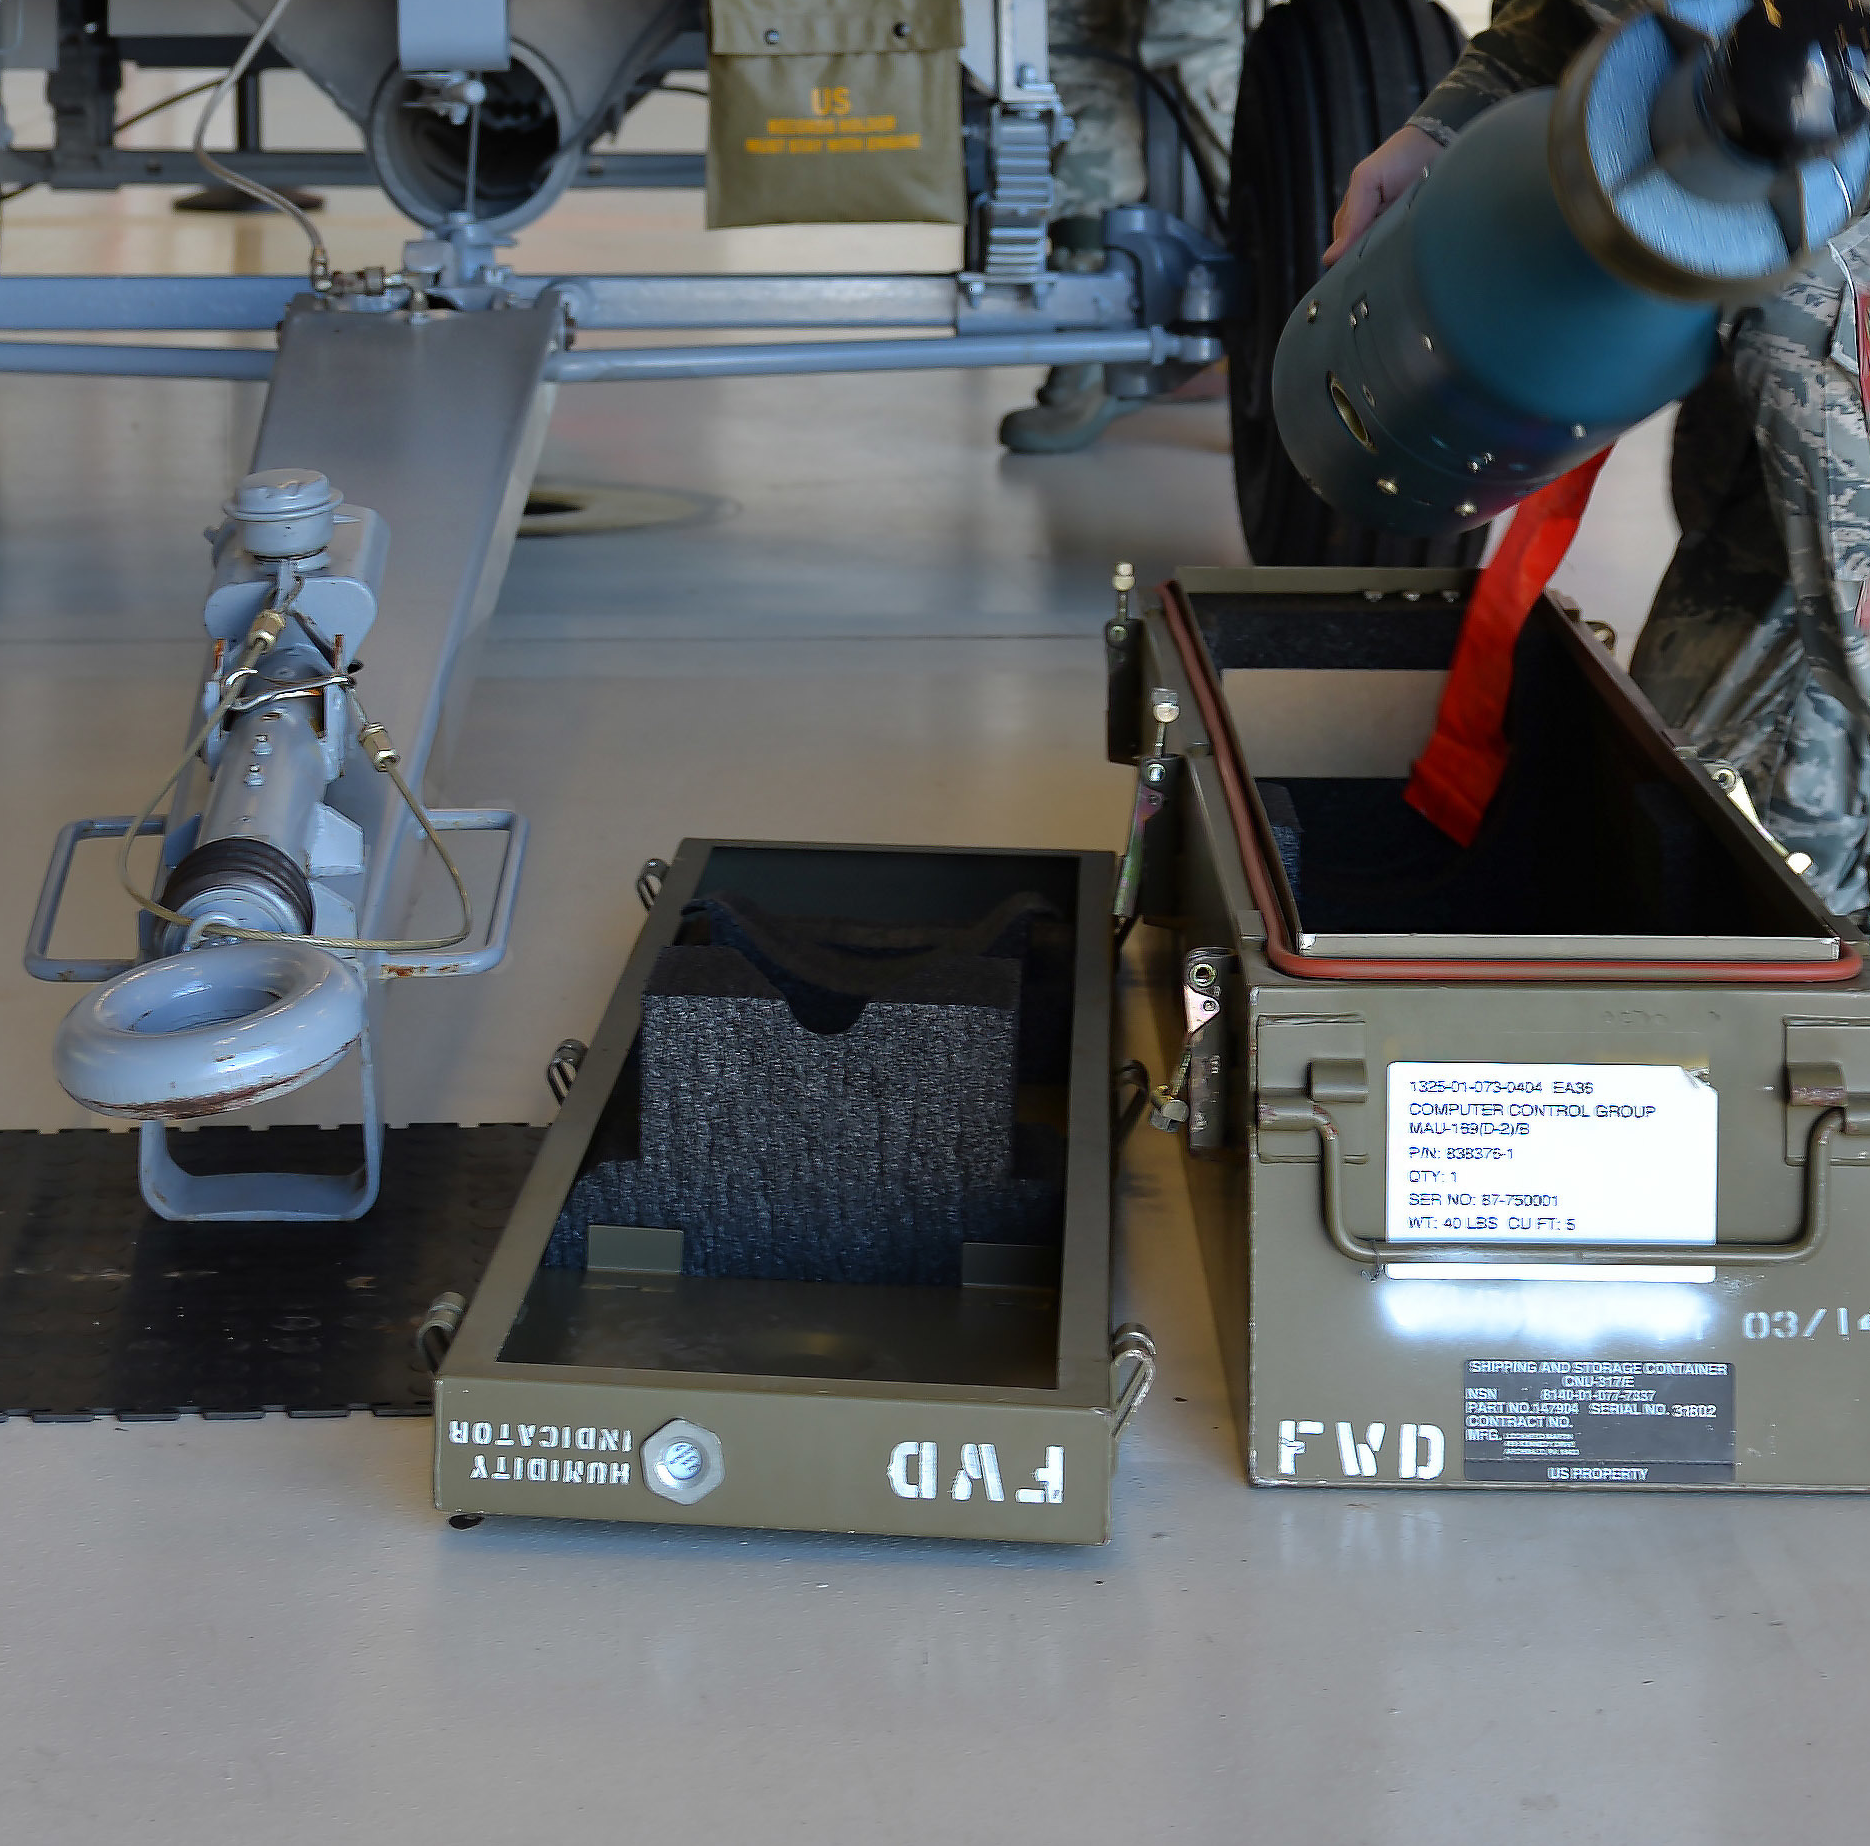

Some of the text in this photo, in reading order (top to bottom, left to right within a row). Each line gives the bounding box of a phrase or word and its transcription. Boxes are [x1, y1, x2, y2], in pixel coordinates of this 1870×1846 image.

[810, 85, 853, 116] US
[1409, 1080, 1543, 1095] 1325-01-073-0404
[1408, 1103, 1657, 1120] COMPUTER CONTROL GROUP
[1408, 1146, 1441, 1160] P/N:
[1408, 1170, 1458, 1184] QTY: 1
[1408, 1193, 1442, 1207] SER
[1447, 1193, 1476, 1207] NO:
[1408, 1216, 1438, 1230] WT:
[1443, 1217, 1462, 1230] 40
[1466, 1216, 1499, 1230] LBS
[1508, 1217, 1532, 1231] CU
[1566, 1218, 1577, 1232] 5
[1468, 1360, 1729, 1376] SHIPPING AND STORAGE CONTAINER
[1465, 1387, 1499, 1400] NSN
[1465, 1401, 1506, 1414] PART
[1588, 1403, 1643, 1416] SERIAL
[1643, 1403, 1670, 1416] NO.
[1465, 1415, 1574, 1429] CONTRACT NO.
[447, 1418, 632, 1453] INDICATOR
[1276, 1419, 1448, 1482] FWD
[468, 1453, 632, 1488] HUMIDITY
[887, 1440, 1066, 1505] FWD
[1547, 1467, 1649, 1482] US PROPERTY
